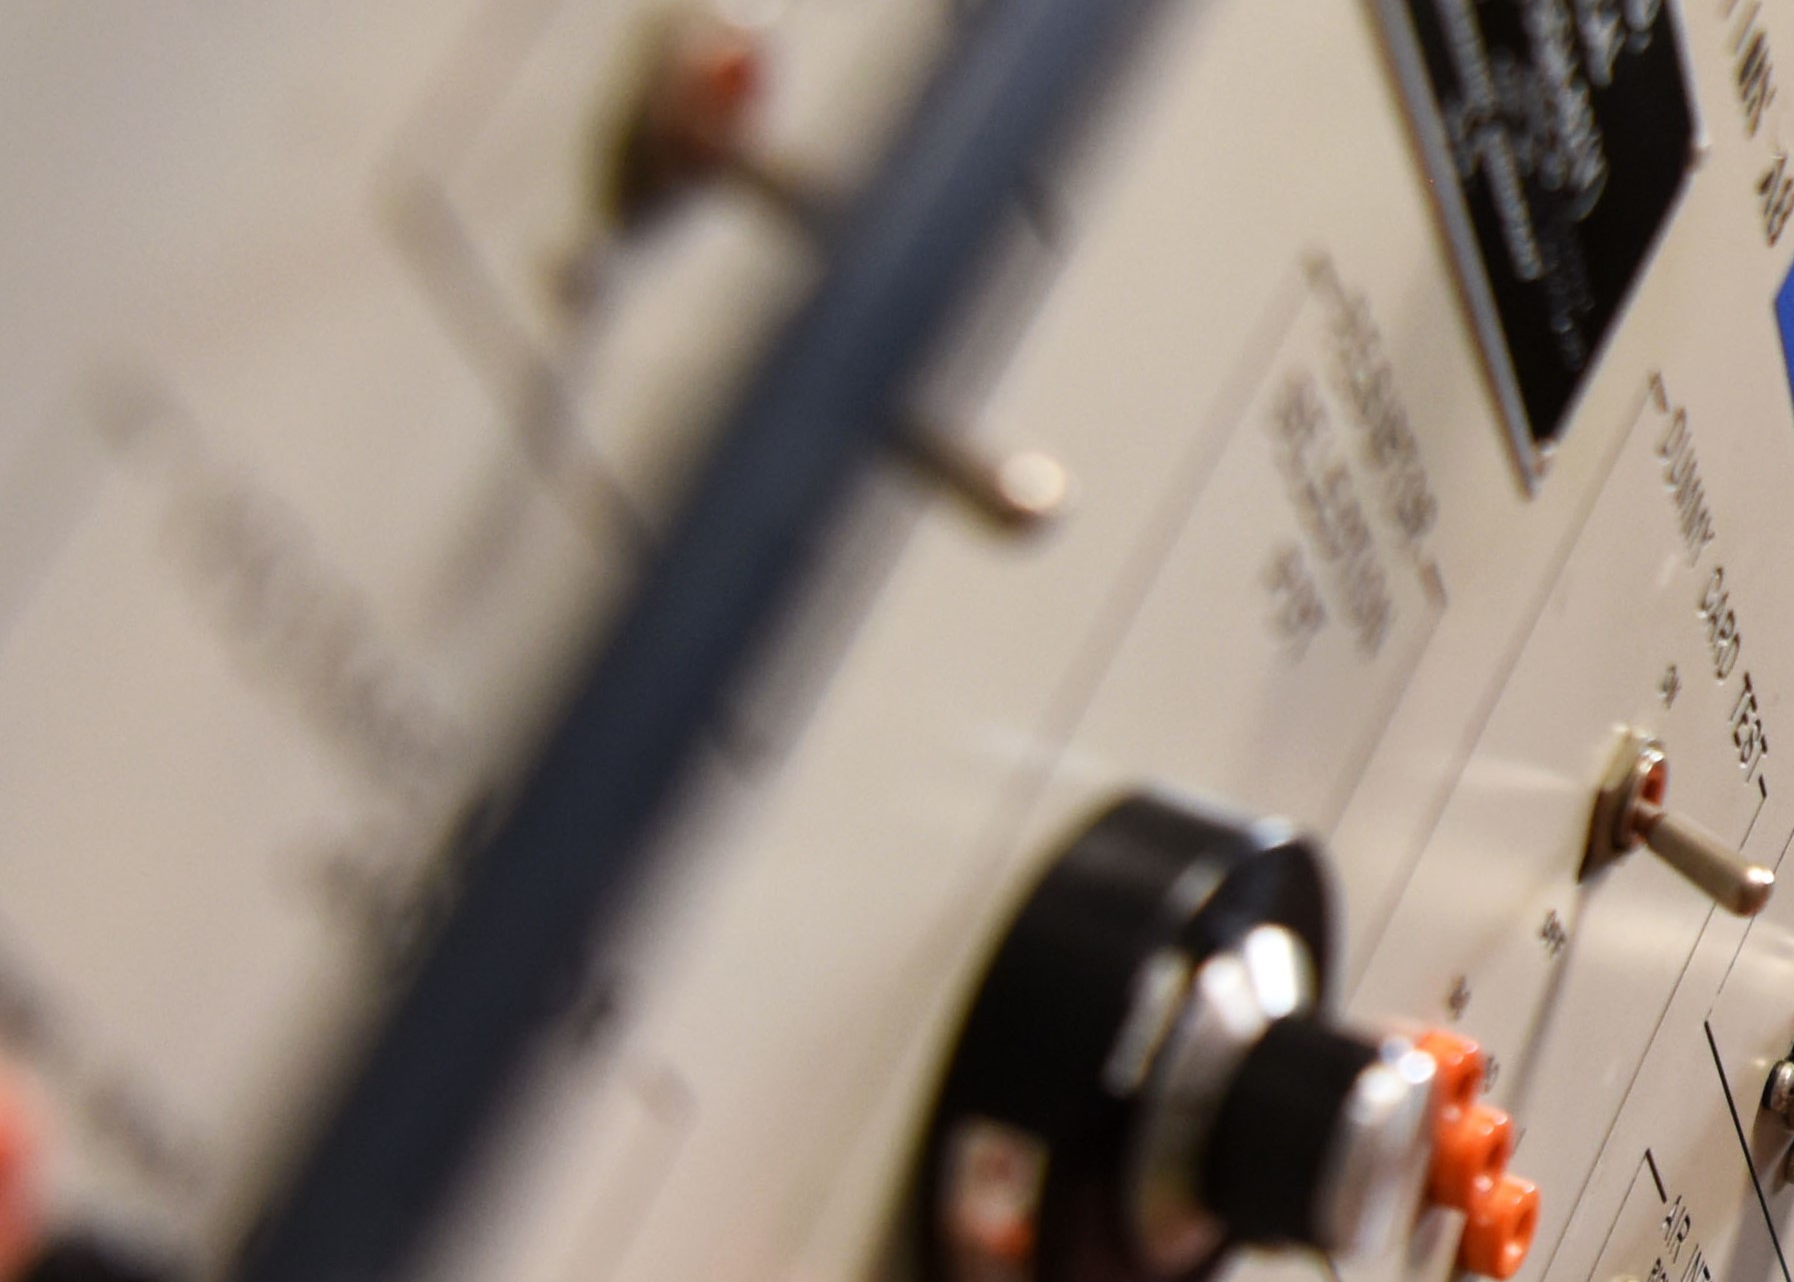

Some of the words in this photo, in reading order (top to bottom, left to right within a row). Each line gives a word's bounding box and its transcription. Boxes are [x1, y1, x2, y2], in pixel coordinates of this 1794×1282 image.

[1656, 404, 1715, 568] DUMMY
[1698, 565, 1741, 682] CARD
[1730, 671, 1769, 784] TEST
[1664, 1194, 1691, 1264] AIR
